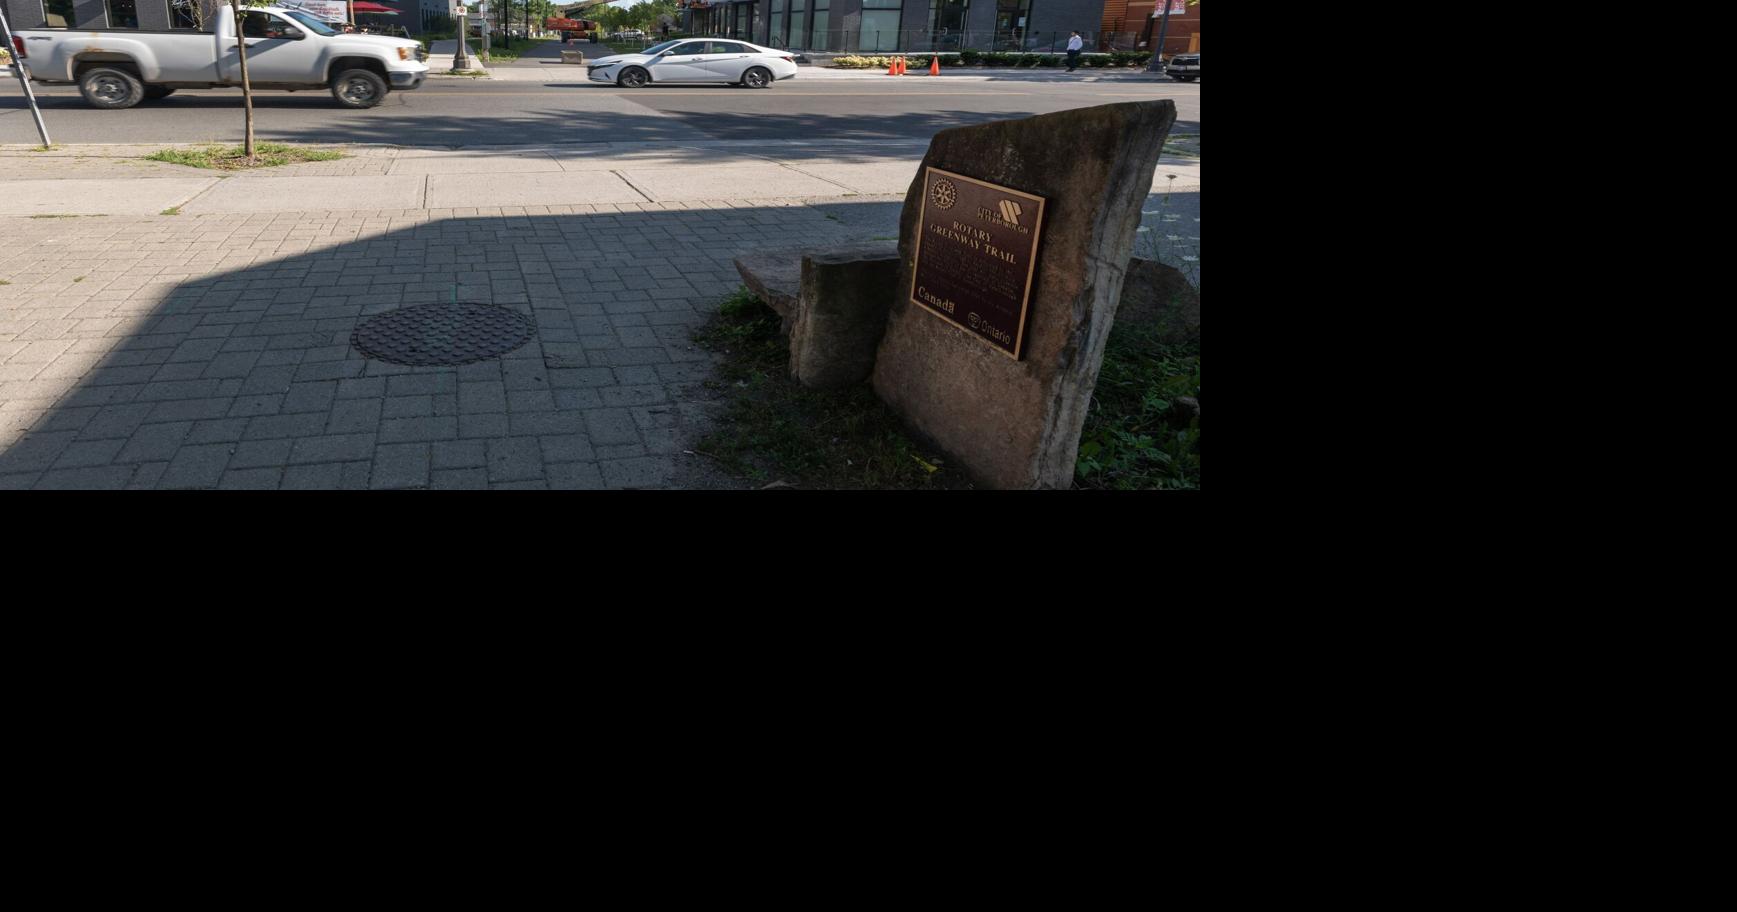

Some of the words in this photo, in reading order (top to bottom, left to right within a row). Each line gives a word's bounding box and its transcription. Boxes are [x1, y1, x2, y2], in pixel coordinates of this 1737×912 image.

[977, 206, 992, 216] CITY
[930, 223, 980, 249] GREENWAY
[984, 243, 1016, 264] TRAIL
[953, 220, 992, 242] ROTARY
[918, 286, 955, 314] Canada
[981, 320, 1011, 345] Ontario
